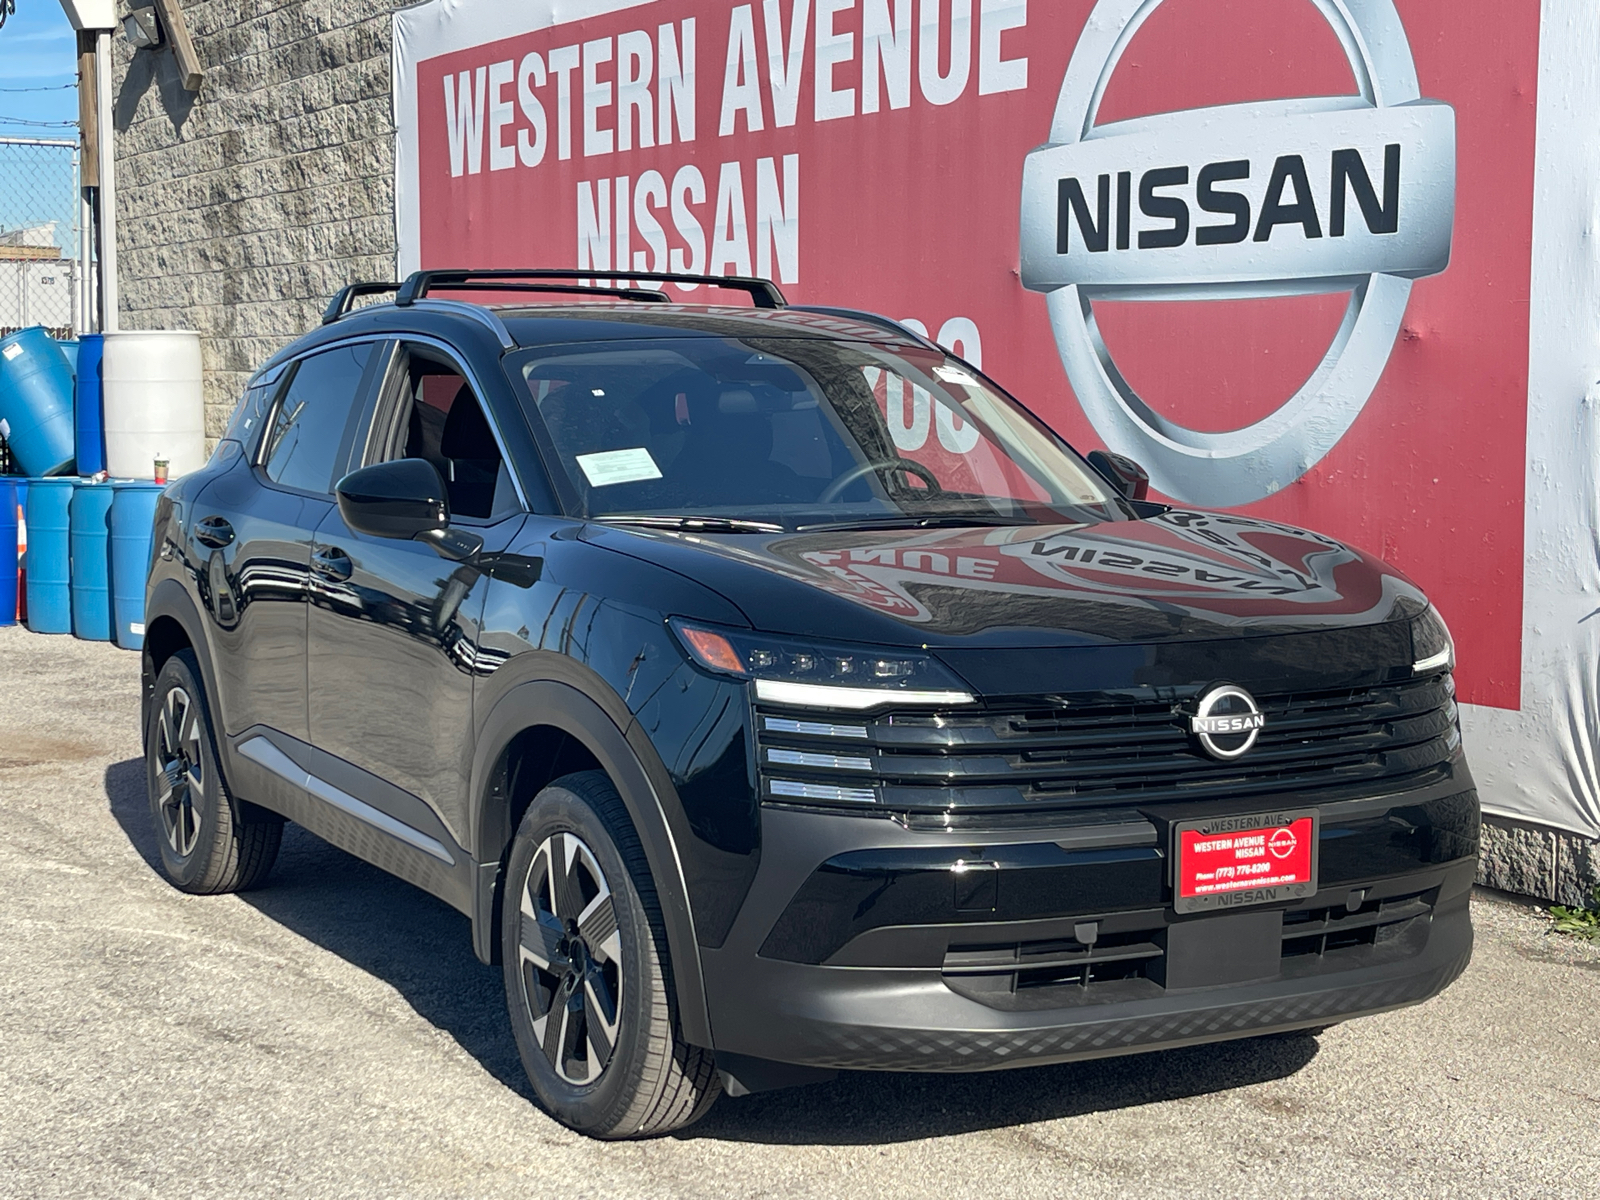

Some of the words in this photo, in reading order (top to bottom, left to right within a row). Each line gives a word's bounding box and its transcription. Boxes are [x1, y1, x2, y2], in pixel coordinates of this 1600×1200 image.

[443, 17, 696, 178] WESTERN
[719, 0, 1029, 137] AVENUE
[1056, 143, 1400, 255] NISSAN
[577, 153, 800, 292] NISSAN
[1194, 714, 1264, 731] NISSAN
[1211, 817, 1261, 832] WESTERN
[1194, 838, 1233, 853] WESTERN
[1233, 835, 1266, 848] AVENUE
[1268, 839, 1297, 848] NISSAN
[1235, 847, 1265, 859] NISSAN
[1215, 866, 1235, 880] (773)
[1217, 888, 1277, 906] NISSAN
